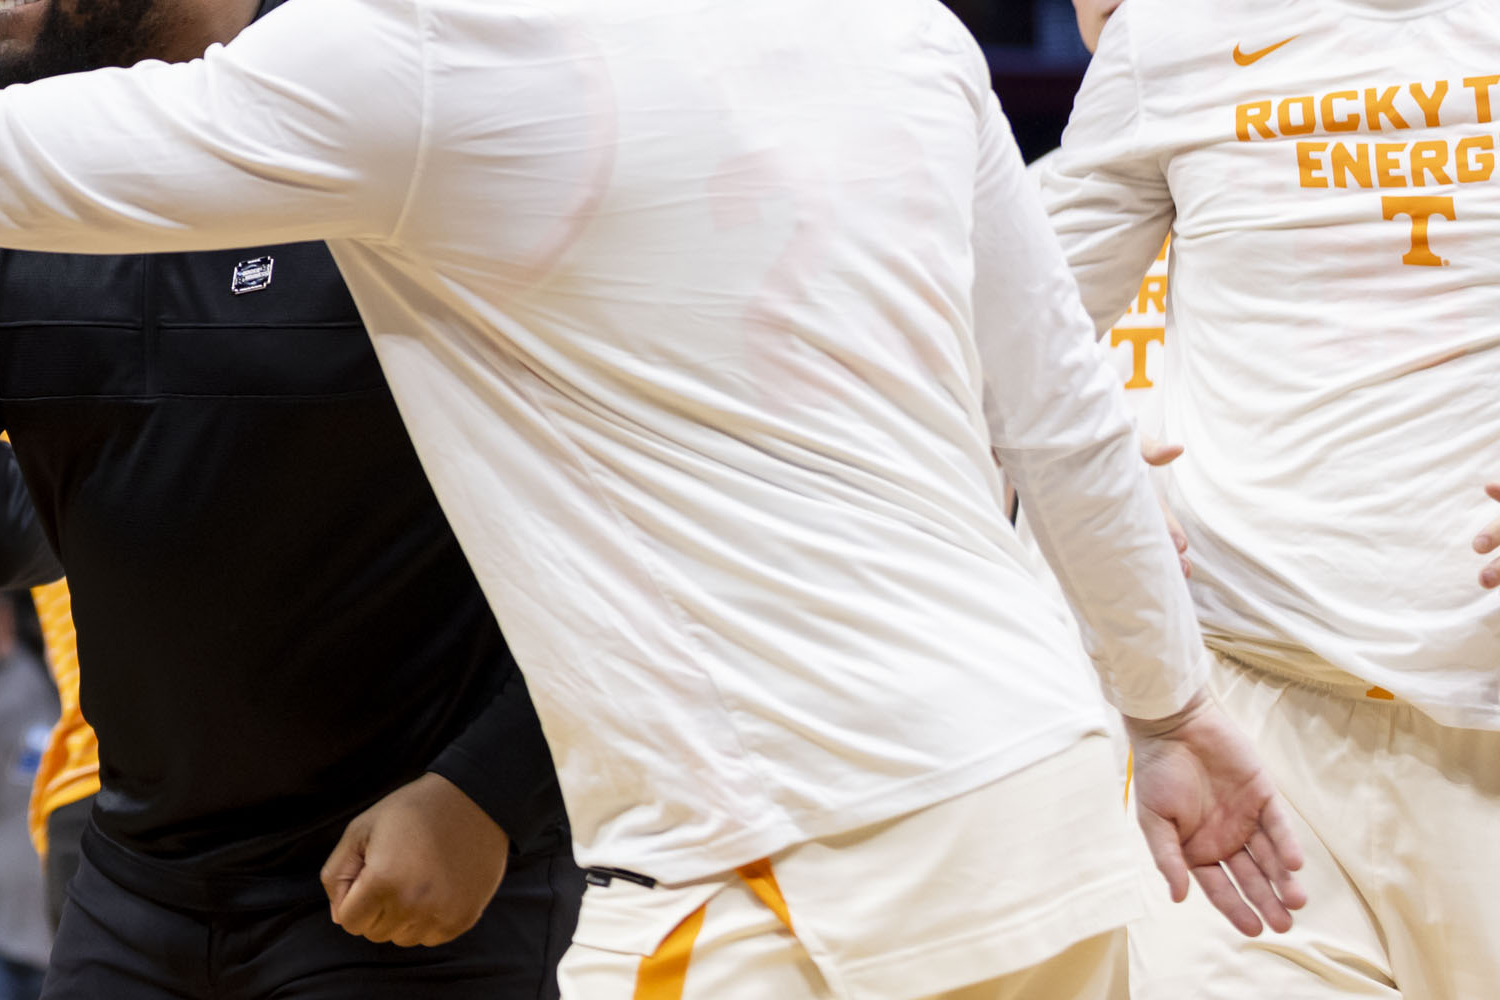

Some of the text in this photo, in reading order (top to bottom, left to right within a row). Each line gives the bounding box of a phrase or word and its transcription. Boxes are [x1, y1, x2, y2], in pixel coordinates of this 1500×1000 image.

[1235, 79, 1449, 142] ROCKY
[1295, 134, 1500, 189] ENERG
[1380, 195, 1457, 267] T
